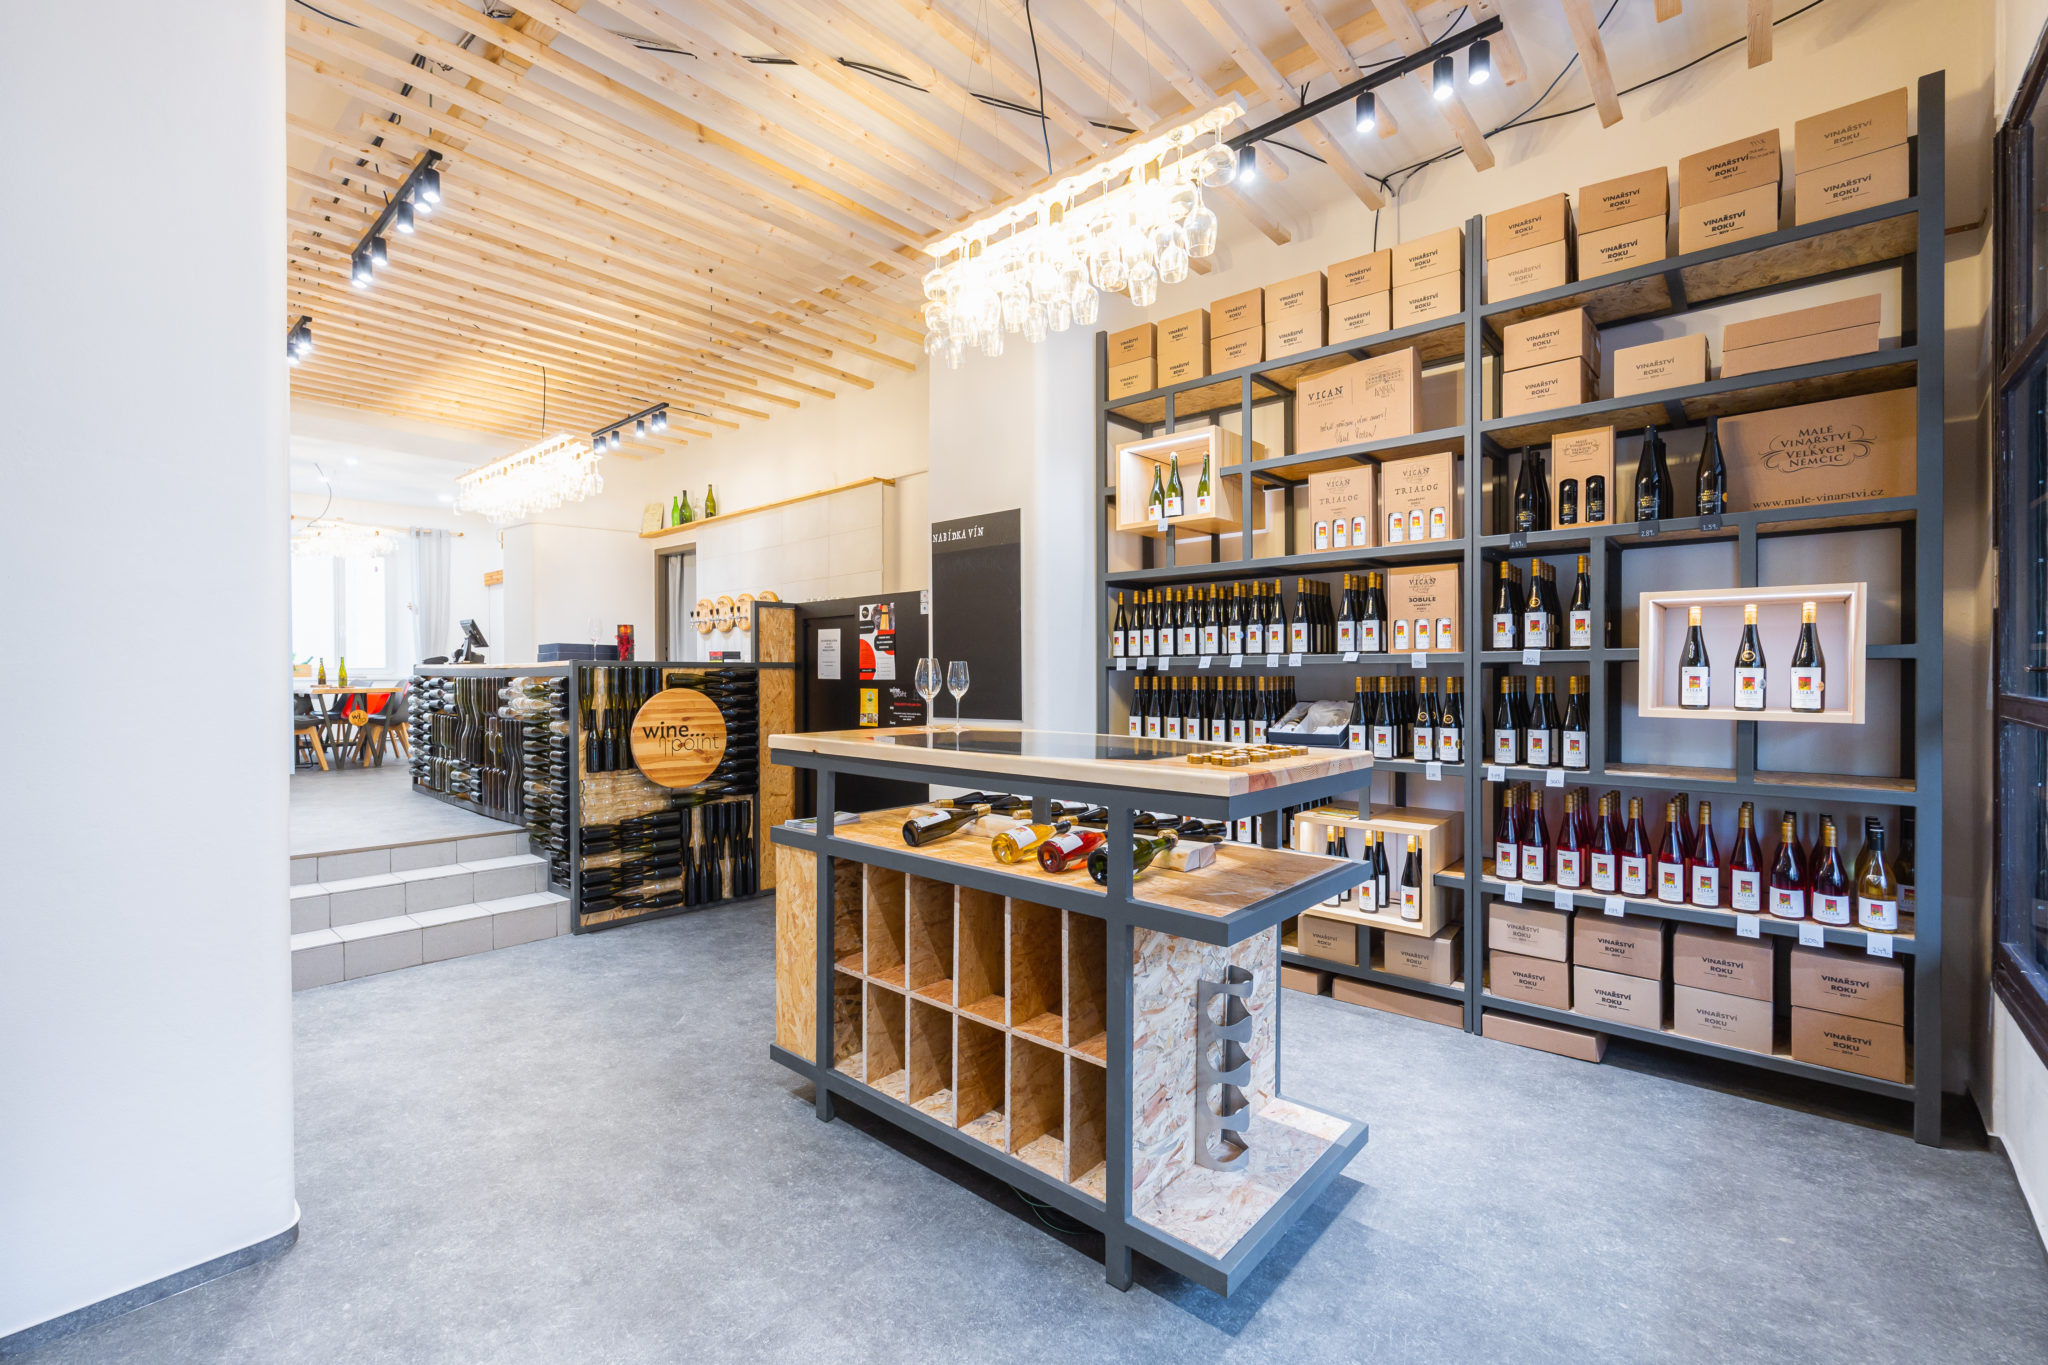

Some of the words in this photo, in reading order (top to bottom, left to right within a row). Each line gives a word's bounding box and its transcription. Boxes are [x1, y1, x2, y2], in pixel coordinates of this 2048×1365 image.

[1824, 119, 1872, 139] VINAŘSTVÍ
[1833, 132, 1860, 145] ROKU
[1706, 153, 1749, 172] VINAŘSTVÍ
[1715, 166, 1738, 177] ROKU
[1823, 173, 1872, 193] VINAŘSTVÍ
[1602, 188, 1640, 203] VINAŘSTVÍ
[1832, 186, 1859, 199] ROKU
[1609, 198, 1631, 208] ROKU
[1508, 215, 1542, 230] VINAŘSTVÍ
[1703, 209, 1746, 227] VINAŘSTVÍ
[1514, 225, 1533, 235] ROKU
[1711, 221, 1735, 232] ROKU
[1600, 239, 1638, 254] VINAŘSTVÍ
[1607, 250, 1629, 259] ROKU
[1414, 259, 1431, 267] ROKU
[1508, 264, 1542, 277] VINAŘSTVÍ
[1514, 273, 1533, 282] ROKU
[1414, 301, 1431, 309] ROKU
[1526, 329, 1560, 342] VINAŘSTVÍ
[1532, 339, 1551, 348] ROKU
[1635, 357, 1675, 370] VINAŘSTVÍ
[1643, 367, 1665, 376] ROKU
[1525, 378, 1559, 390] VINAŘSTVÍ
[1308, 385, 1344, 401] VICAN
[1531, 388, 1550, 396] ROKU
[1403, 468, 1430, 477] VICAN
[1326, 479, 1351, 487] VICAN
[1394, 484, 1438, 496] TRIALOG
[1319, 494, 1358, 505] TRIALOG
[1752, 488, 1885, 509] www.male-vinarstvi.cz
[932, 529, 967, 543] NABÍDKA
[968, 525, 984, 538] VÍN
[1506, 923, 1540, 934] VINAŘSTVÍ
[1512, 931, 1531, 939] ROKU
[1597, 937, 1635, 949] VINAŘSTVÍ
[1604, 946, 1626, 954] ROKU
[1701, 956, 1744, 969] VINAŘSTVÍ
[1710, 966, 1733, 975] ROKU
[1512, 971, 1545, 982] VINAŘSTVÍ
[1821, 975, 1870, 989] VINAŘSTVÍ
[1519, 979, 1537, 987] ROKU
[1594, 989, 1632, 1000] VINAŘSTVÍ
[1830, 984, 1858, 994] ROKU
[1601, 997, 1623, 1006] ROKU
[1696, 1008, 1738, 1022] VINAŘSTVÍ
[1704, 1017, 1727, 1027] ROKU
[1823, 1031, 1872, 1046] VINAŘSTVÍ
[1833, 1041, 1860, 1052] ROKU
